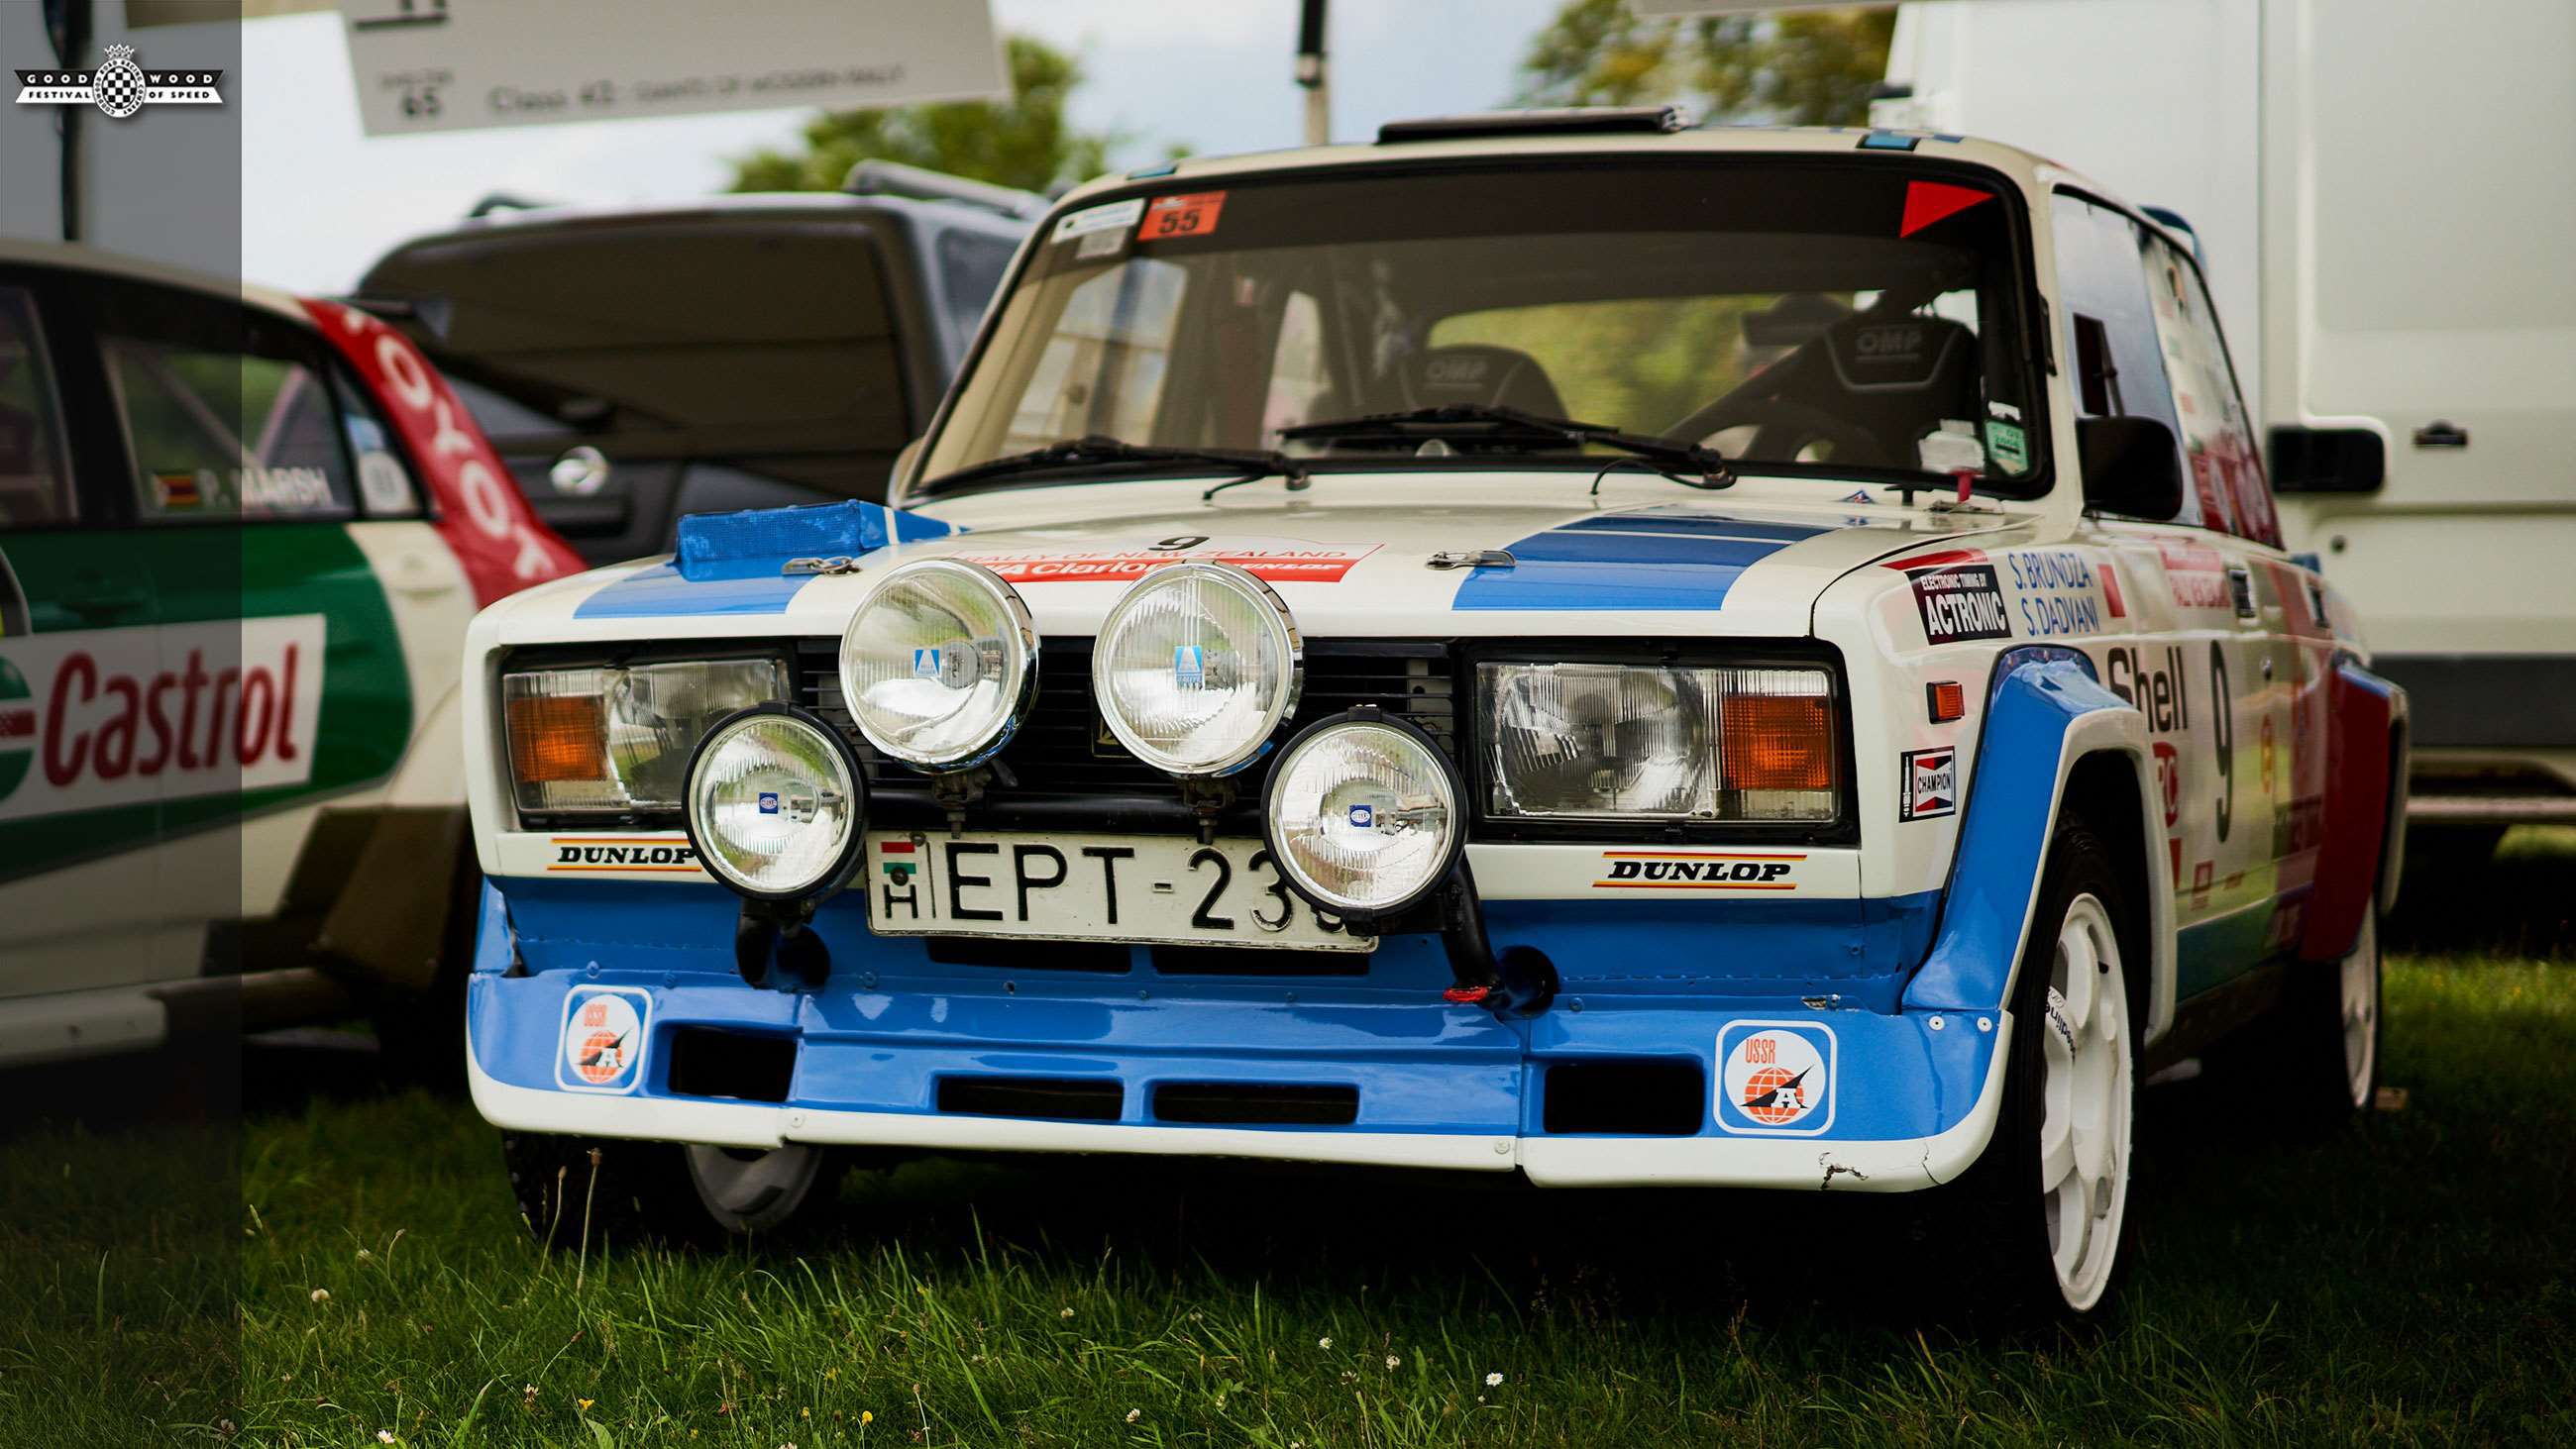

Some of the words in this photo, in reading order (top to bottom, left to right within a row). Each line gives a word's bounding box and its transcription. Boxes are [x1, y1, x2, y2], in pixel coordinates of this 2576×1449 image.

[1156, 208, 1201, 235] 55
[1856, 330, 1922, 354] OMP
[1148, 535, 1211, 551] 9
[2022, 552, 2093, 589] BRUNDZA
[1925, 590, 2007, 636] ACTRONIC
[2035, 595, 2100, 635] DADVANI
[2106, 646, 2189, 734] Shell
[43, 640, 301, 788] Castrol
[2209, 639, 2233, 843] 9
[1917, 767, 1952, 795] CHAMPION
[557, 846, 697, 865] DUNLOP
[1607, 860, 1791, 881] DUNLOP
[885, 883, 919, 919] H
[1745, 1038, 1776, 1065] USSR
